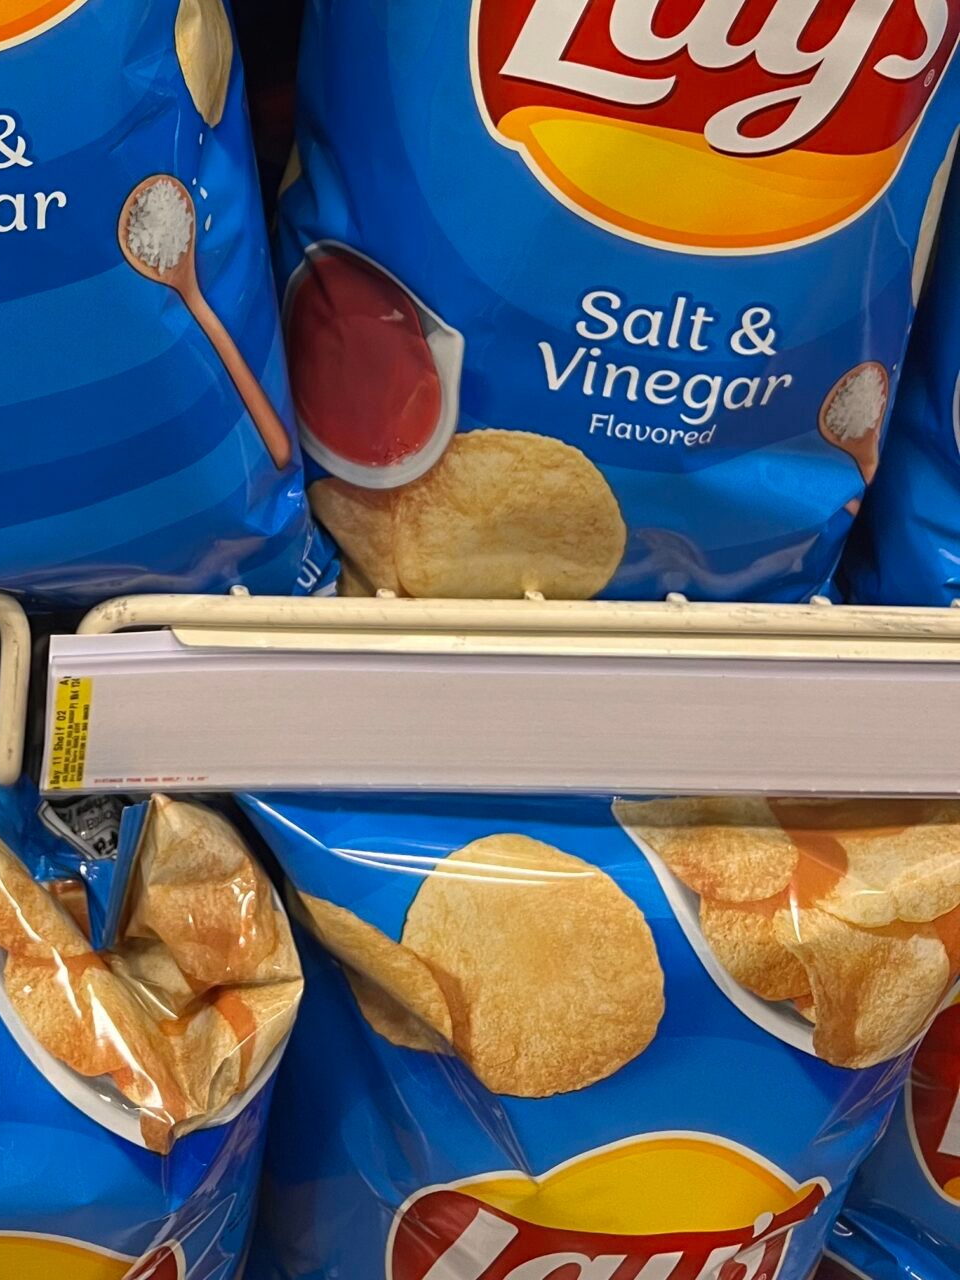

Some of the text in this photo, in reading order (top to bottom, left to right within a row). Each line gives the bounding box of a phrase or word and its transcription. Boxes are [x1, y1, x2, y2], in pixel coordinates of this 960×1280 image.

[575, 290, 778, 358] Salt &
[536, 341, 793, 426] Vinegar
[588, 413, 717, 447] Flavored
